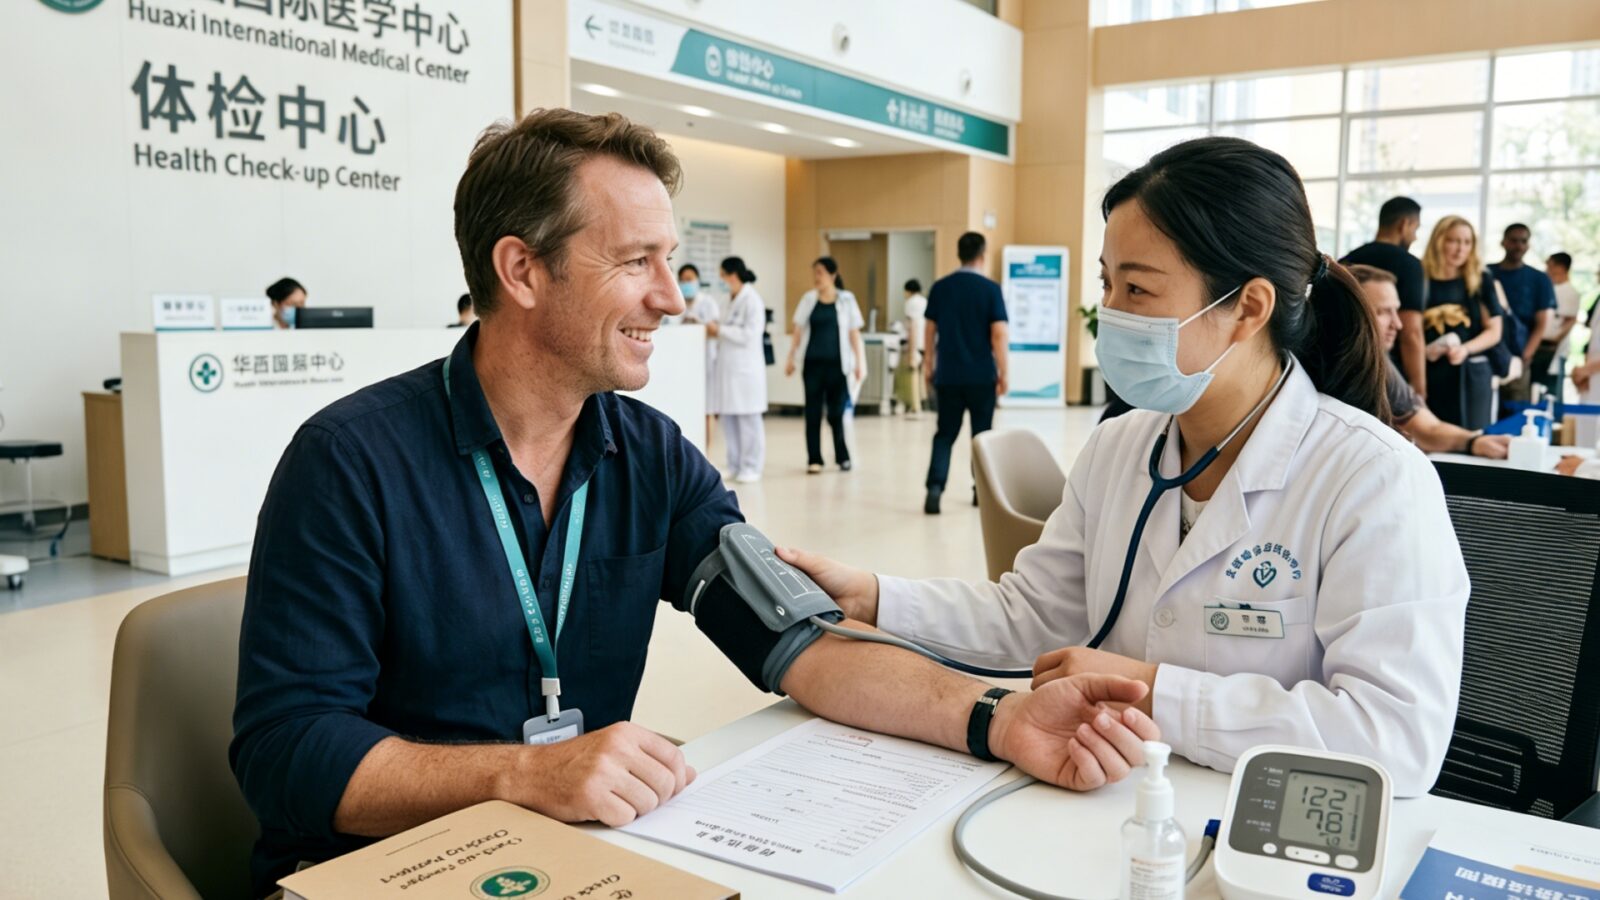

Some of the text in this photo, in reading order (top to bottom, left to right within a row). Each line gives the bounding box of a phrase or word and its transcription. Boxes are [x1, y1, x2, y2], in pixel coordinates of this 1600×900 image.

[128, 0, 471, 84] Huaxi International Medical Center
[130, 60, 387, 157] 体检中心
[133, 142, 402, 193] Health Check-up Center
[1302, 785, 1348, 811] 122
[1305, 808, 1344, 834] 78
